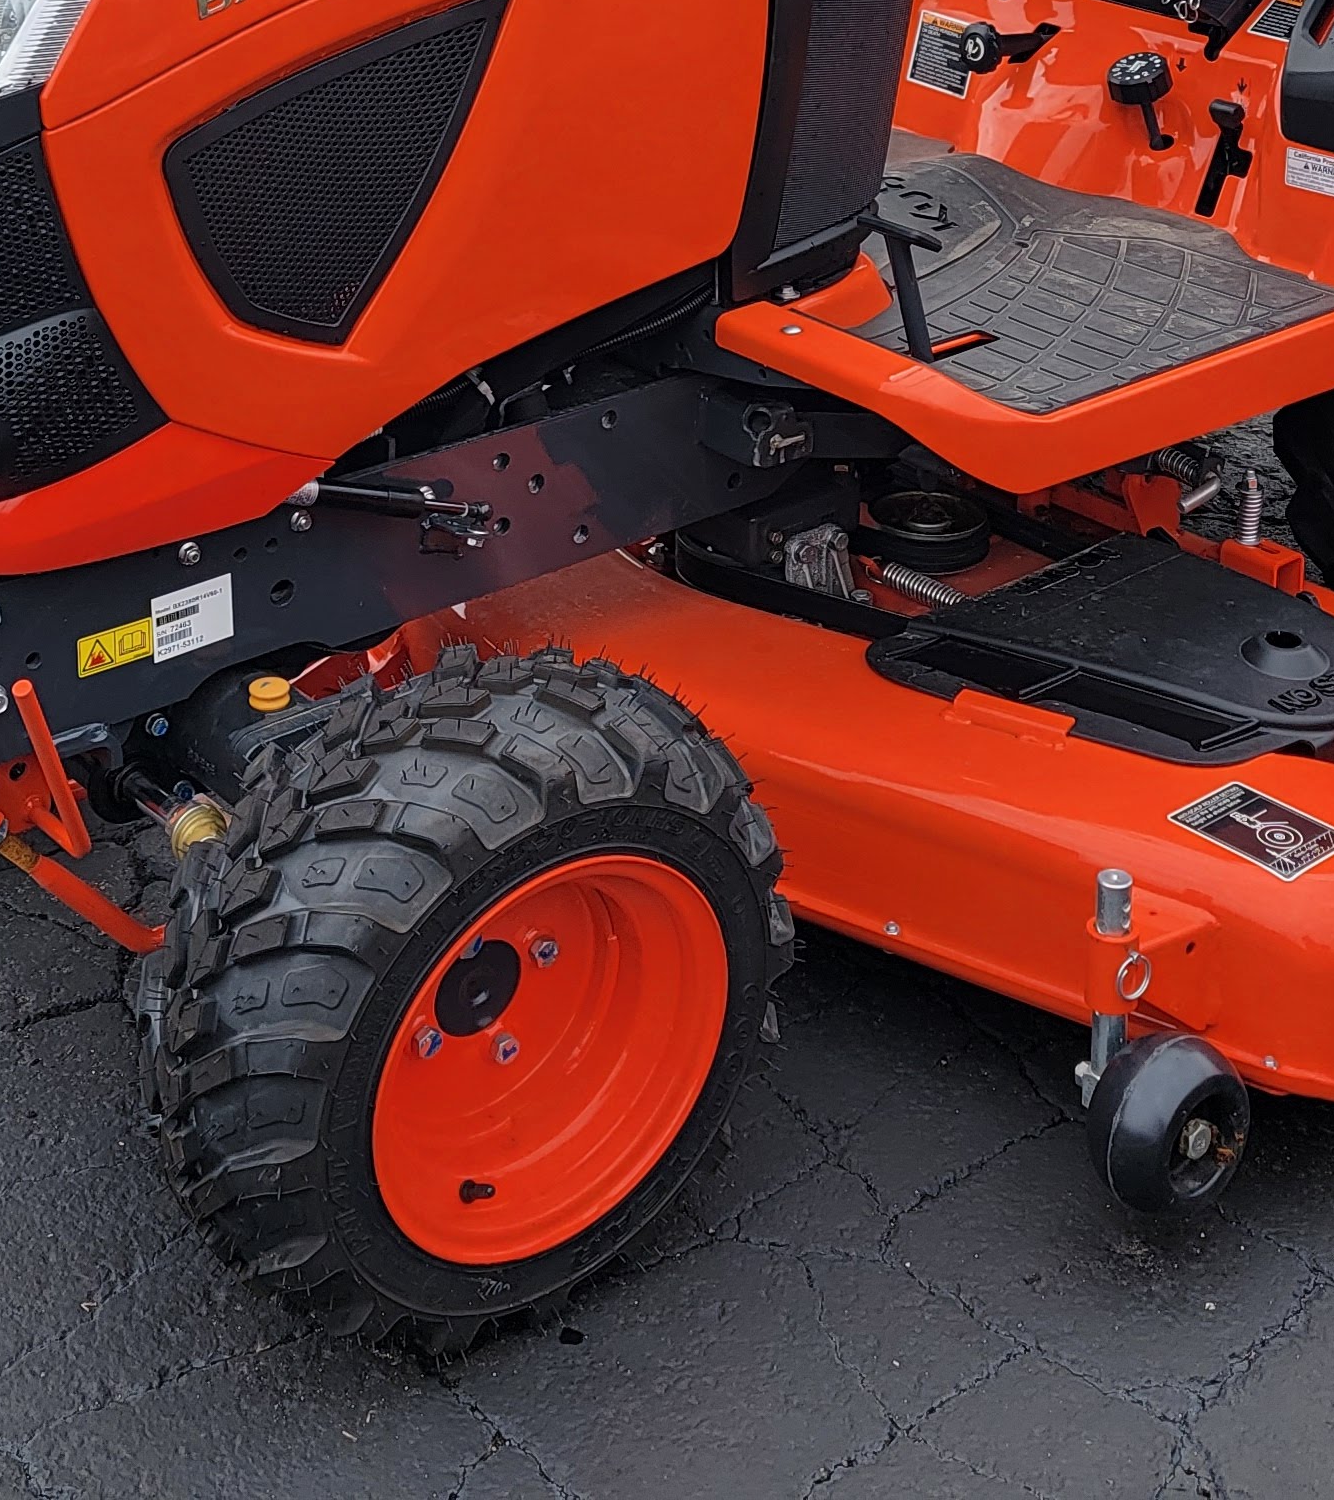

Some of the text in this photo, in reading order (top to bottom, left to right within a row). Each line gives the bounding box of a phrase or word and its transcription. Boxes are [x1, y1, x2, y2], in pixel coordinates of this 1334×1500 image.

[1293, 151, 1321, 162] California
[157, 635, 204, 657] K2971-53112
[1267, 688, 1322, 715] NO
